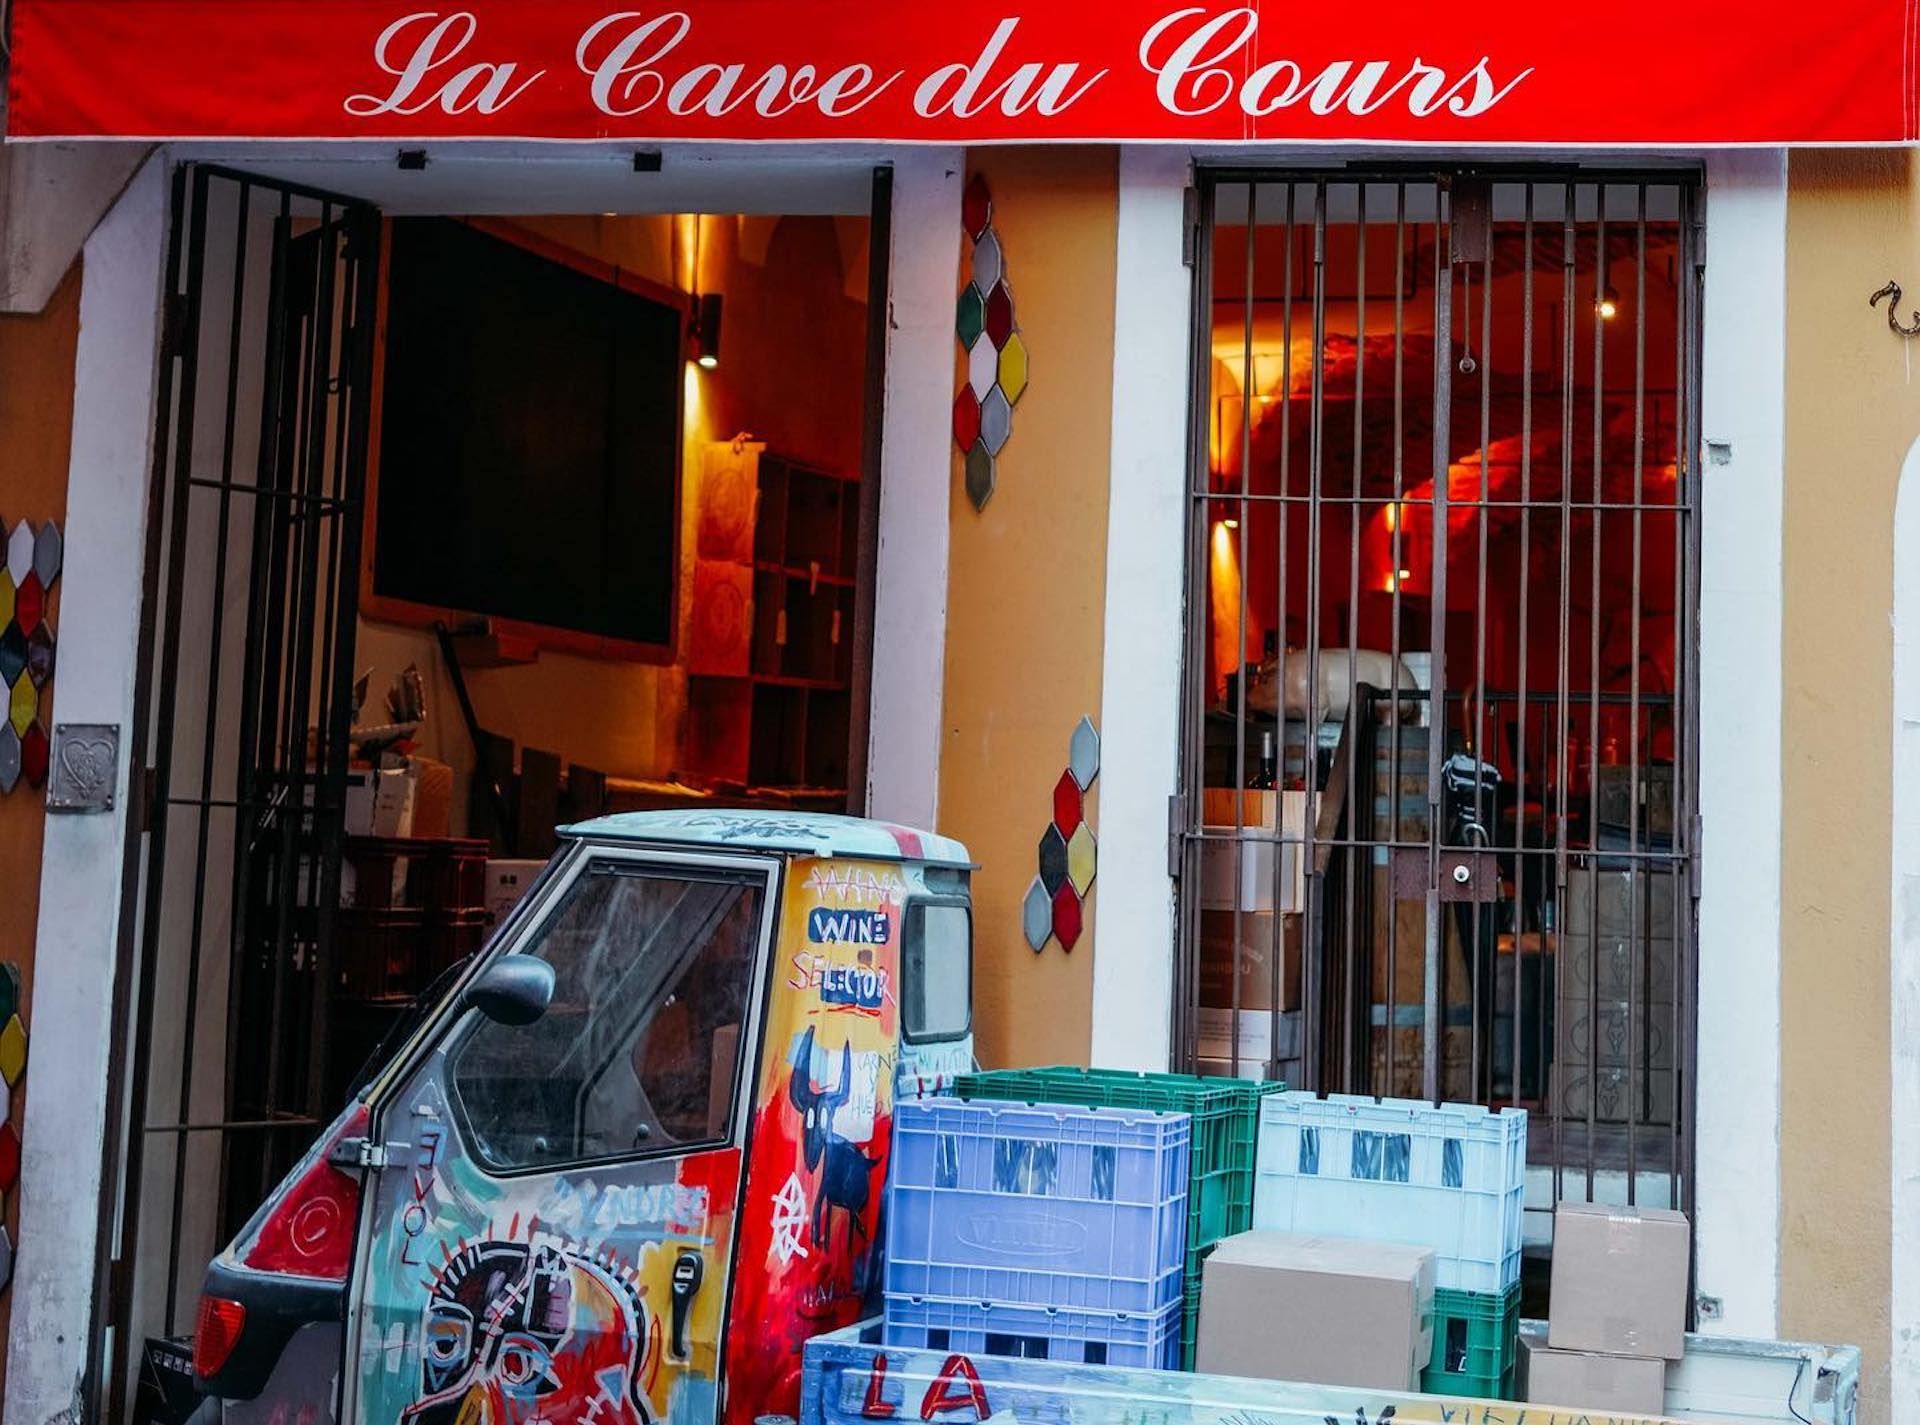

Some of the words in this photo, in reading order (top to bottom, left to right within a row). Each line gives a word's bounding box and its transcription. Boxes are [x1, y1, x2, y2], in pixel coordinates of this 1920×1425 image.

[343, 12, 546, 117] La
[575, 11, 904, 118] Cave
[913, 16, 1109, 118] du
[1138, 7, 1535, 117] Cours
[814, 912, 886, 944] WINE
[861, 1353, 991, 1421] LA
